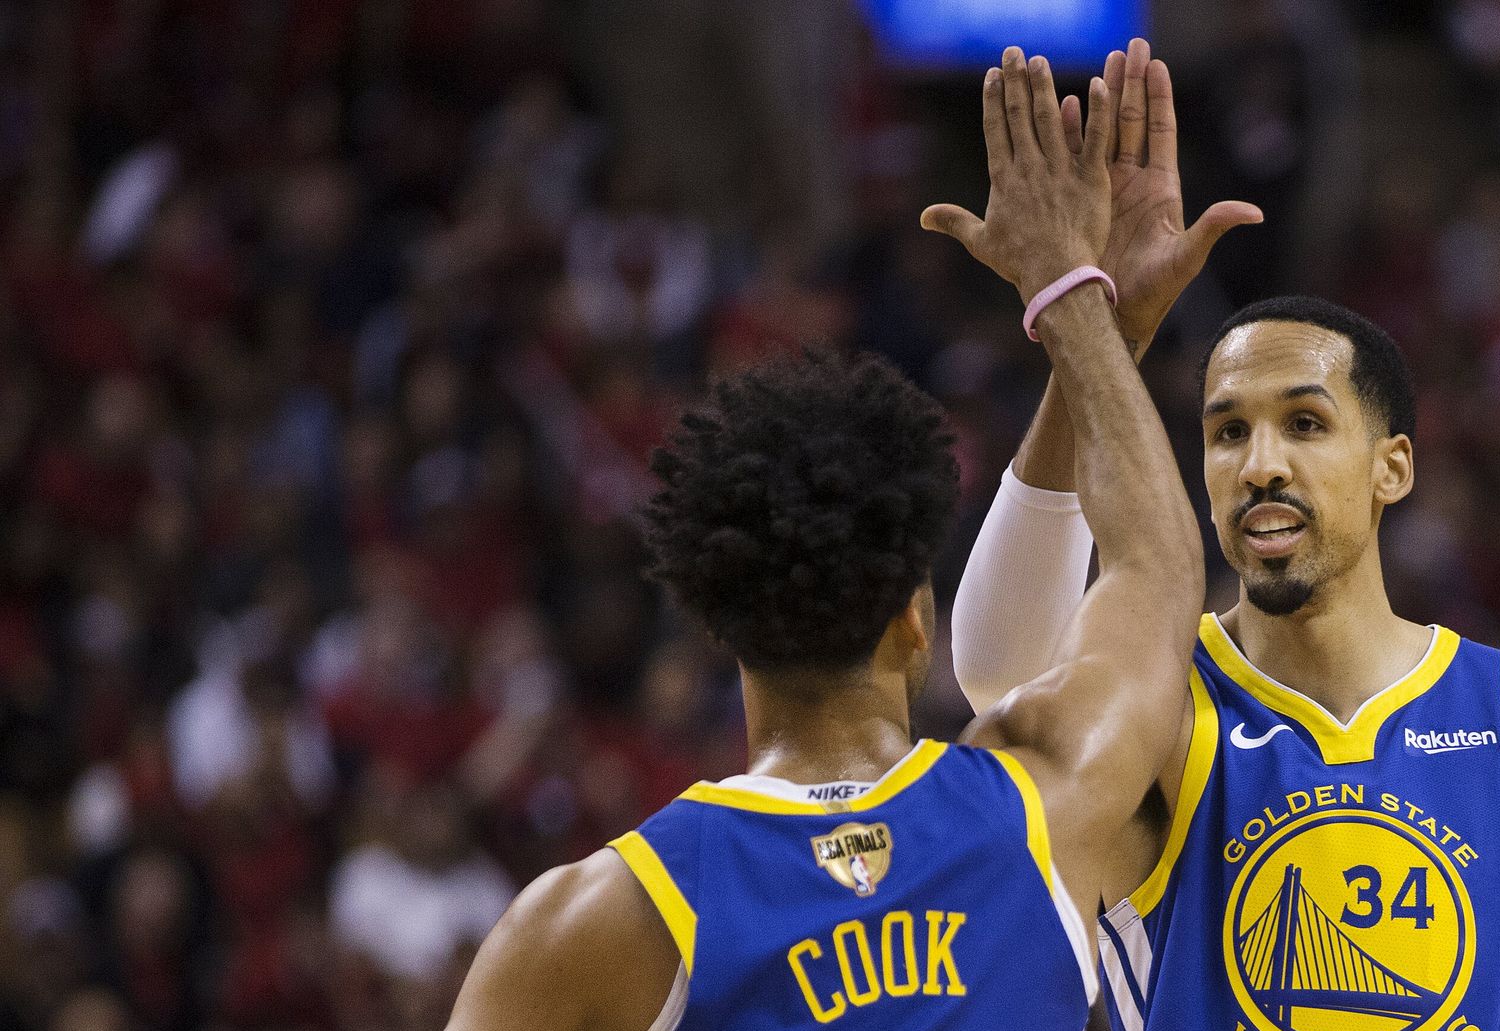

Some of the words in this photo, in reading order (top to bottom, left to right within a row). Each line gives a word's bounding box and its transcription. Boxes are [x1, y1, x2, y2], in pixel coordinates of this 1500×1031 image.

[1404, 727, 1498, 751] Rakuten
[807, 785, 856, 800] NIKE
[844, 827, 888, 856] FINALS
[1222, 783, 1364, 864] GOLDEN
[1380, 792, 1480, 869] STATE
[1339, 864, 1435, 930] 34
[787, 910, 967, 1024] COOK
